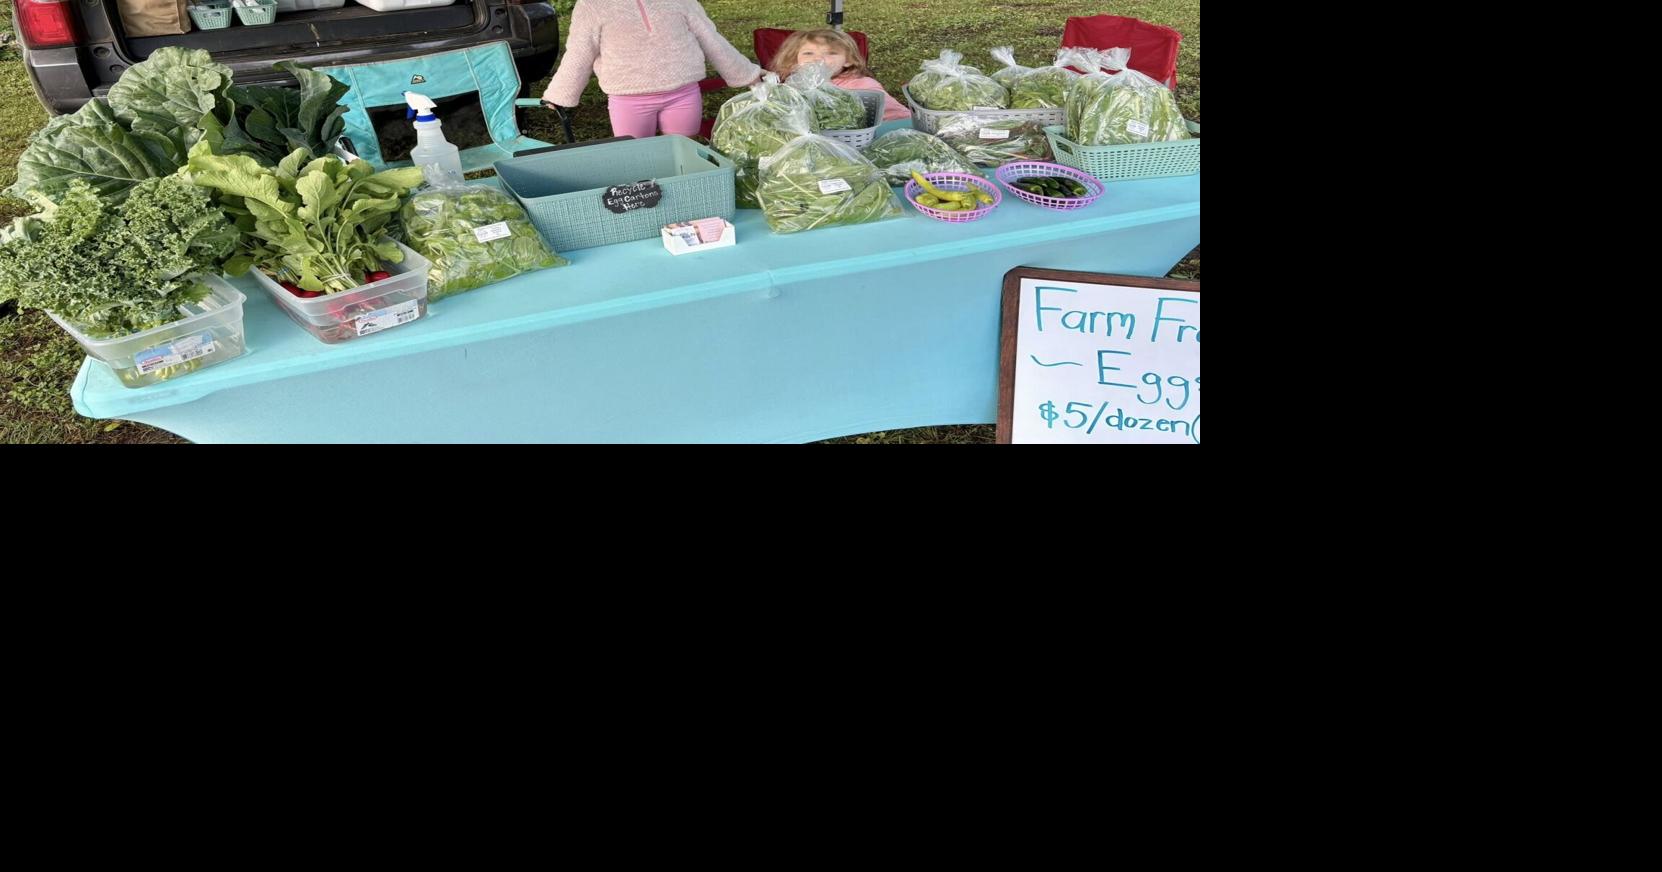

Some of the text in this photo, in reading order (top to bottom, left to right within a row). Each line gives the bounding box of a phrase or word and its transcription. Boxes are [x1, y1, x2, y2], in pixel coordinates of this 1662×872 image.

[607, 190, 659, 208] Egg Cartons
[622, 201, 646, 211] Here
[1035, 286, 1136, 340] Farm
